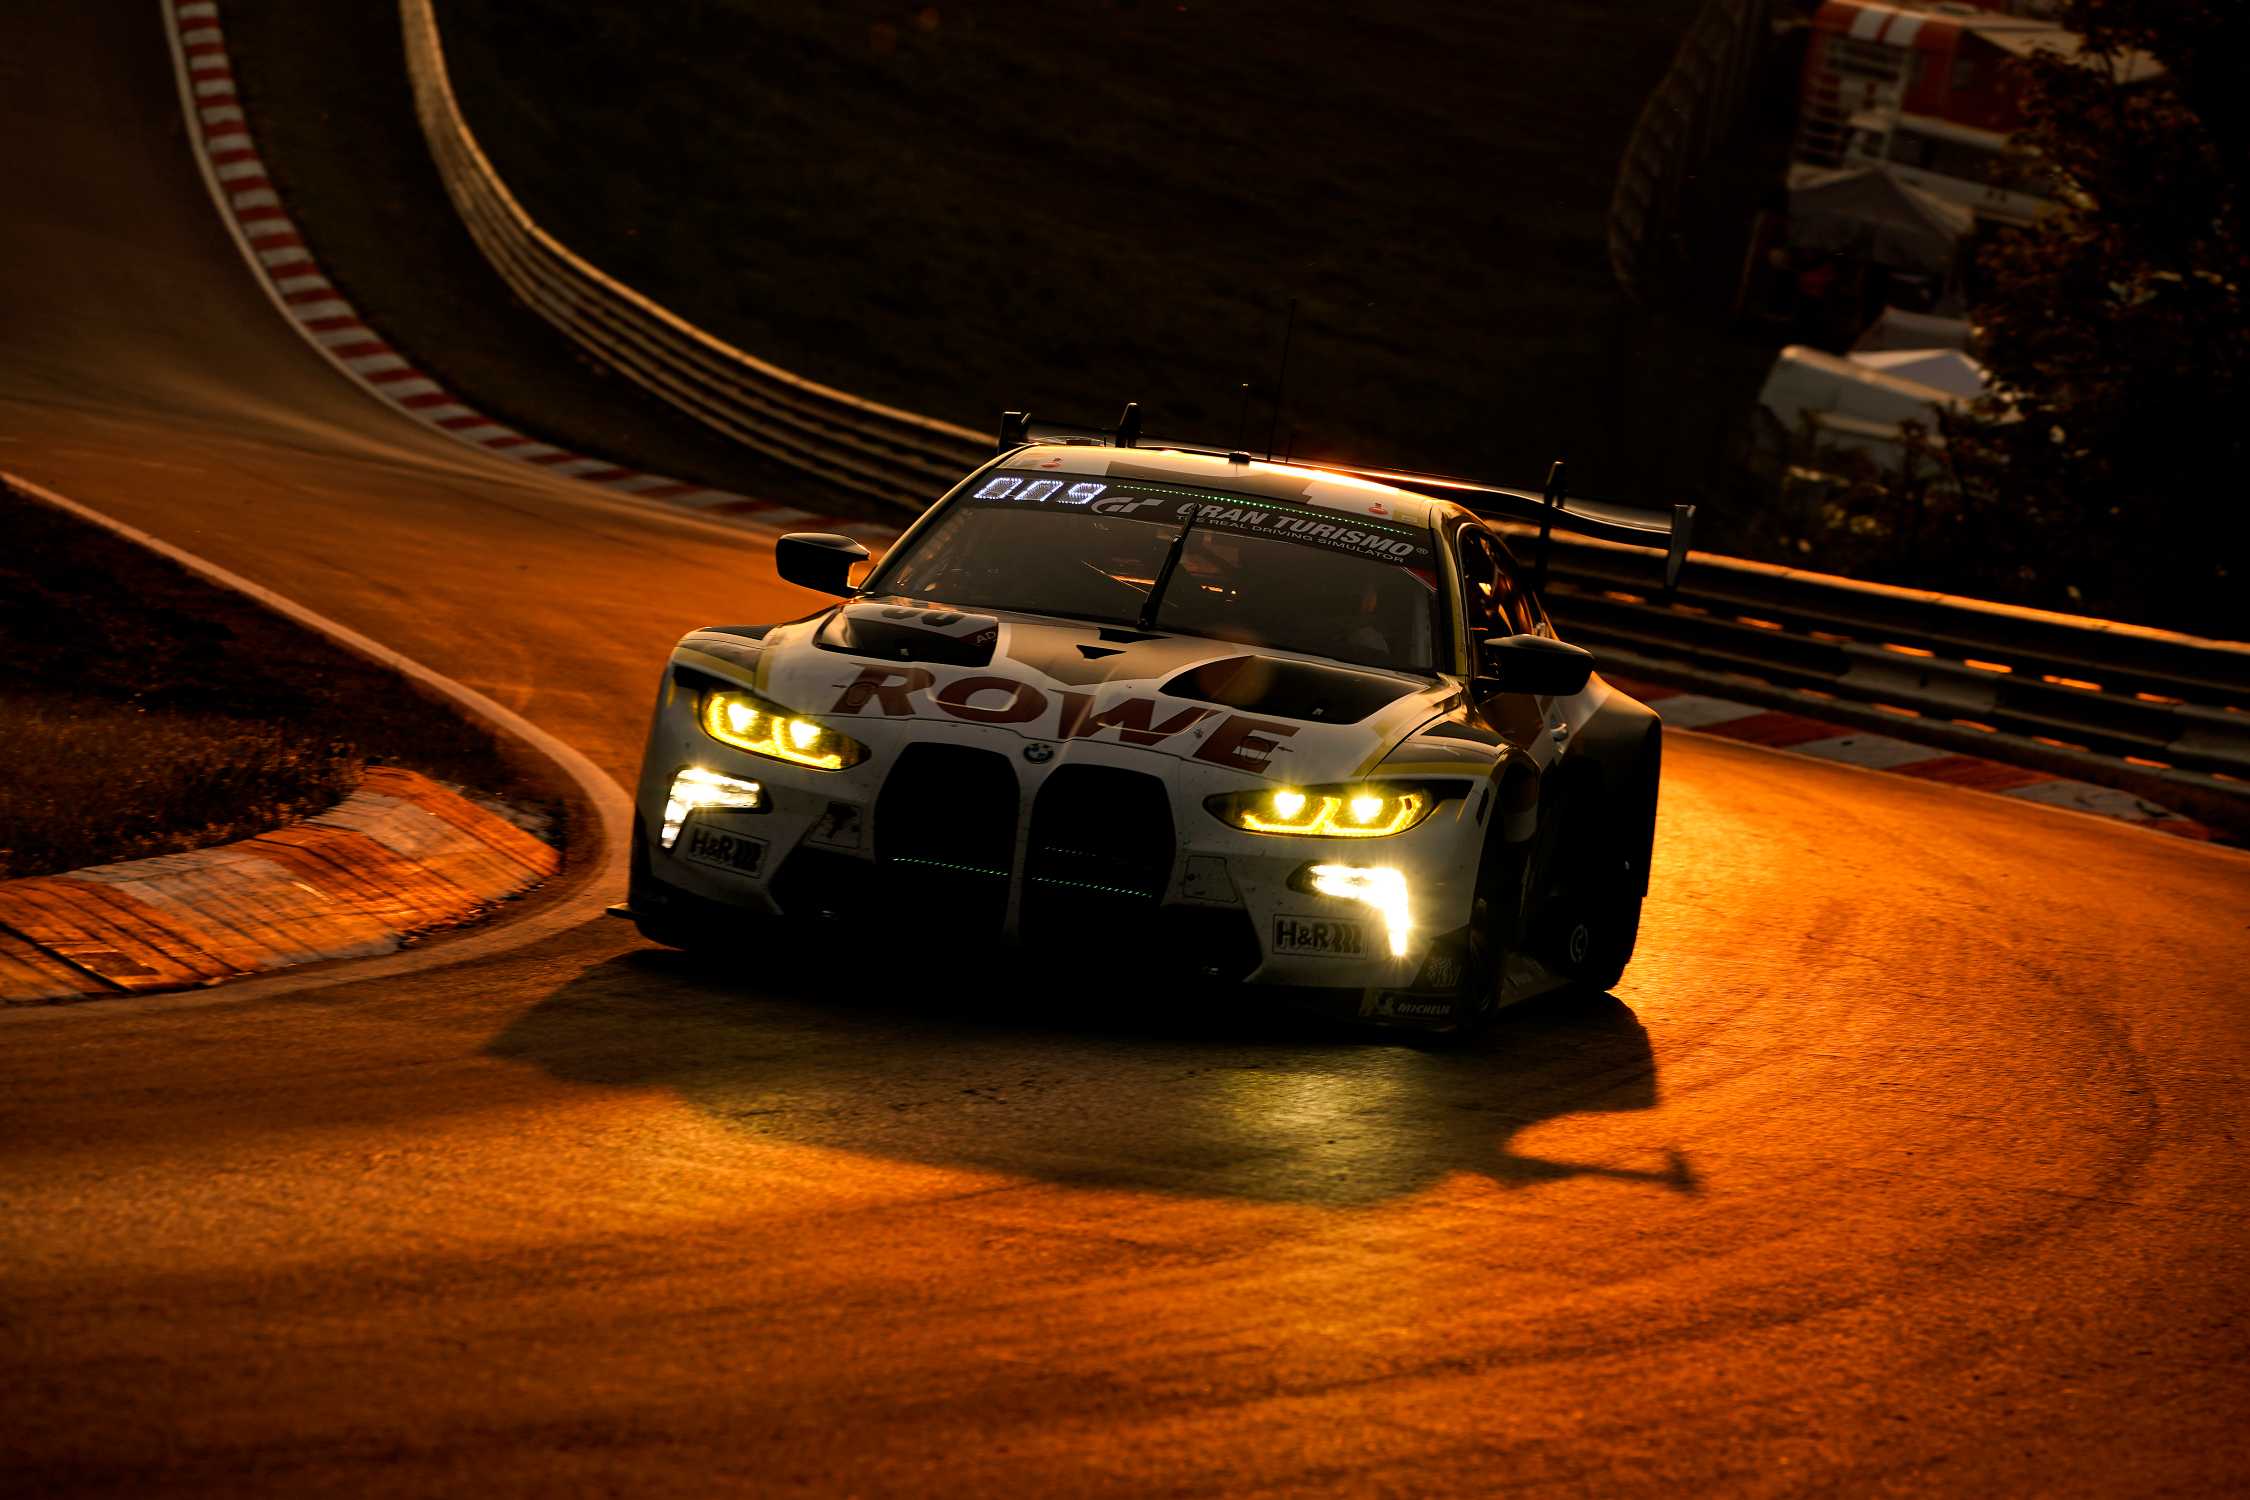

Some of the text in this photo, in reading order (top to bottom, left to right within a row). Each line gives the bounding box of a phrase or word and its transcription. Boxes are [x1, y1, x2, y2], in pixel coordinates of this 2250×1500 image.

[1176, 502, 1270, 525] GRAN
[1209, 519, 1247, 529] REAL
[1252, 526, 1313, 542] DRIVING
[1318, 537, 1405, 564] SIMULATOR
[831, 662, 1301, 774] ROWE
[1276, 920, 1329, 948] H&R
